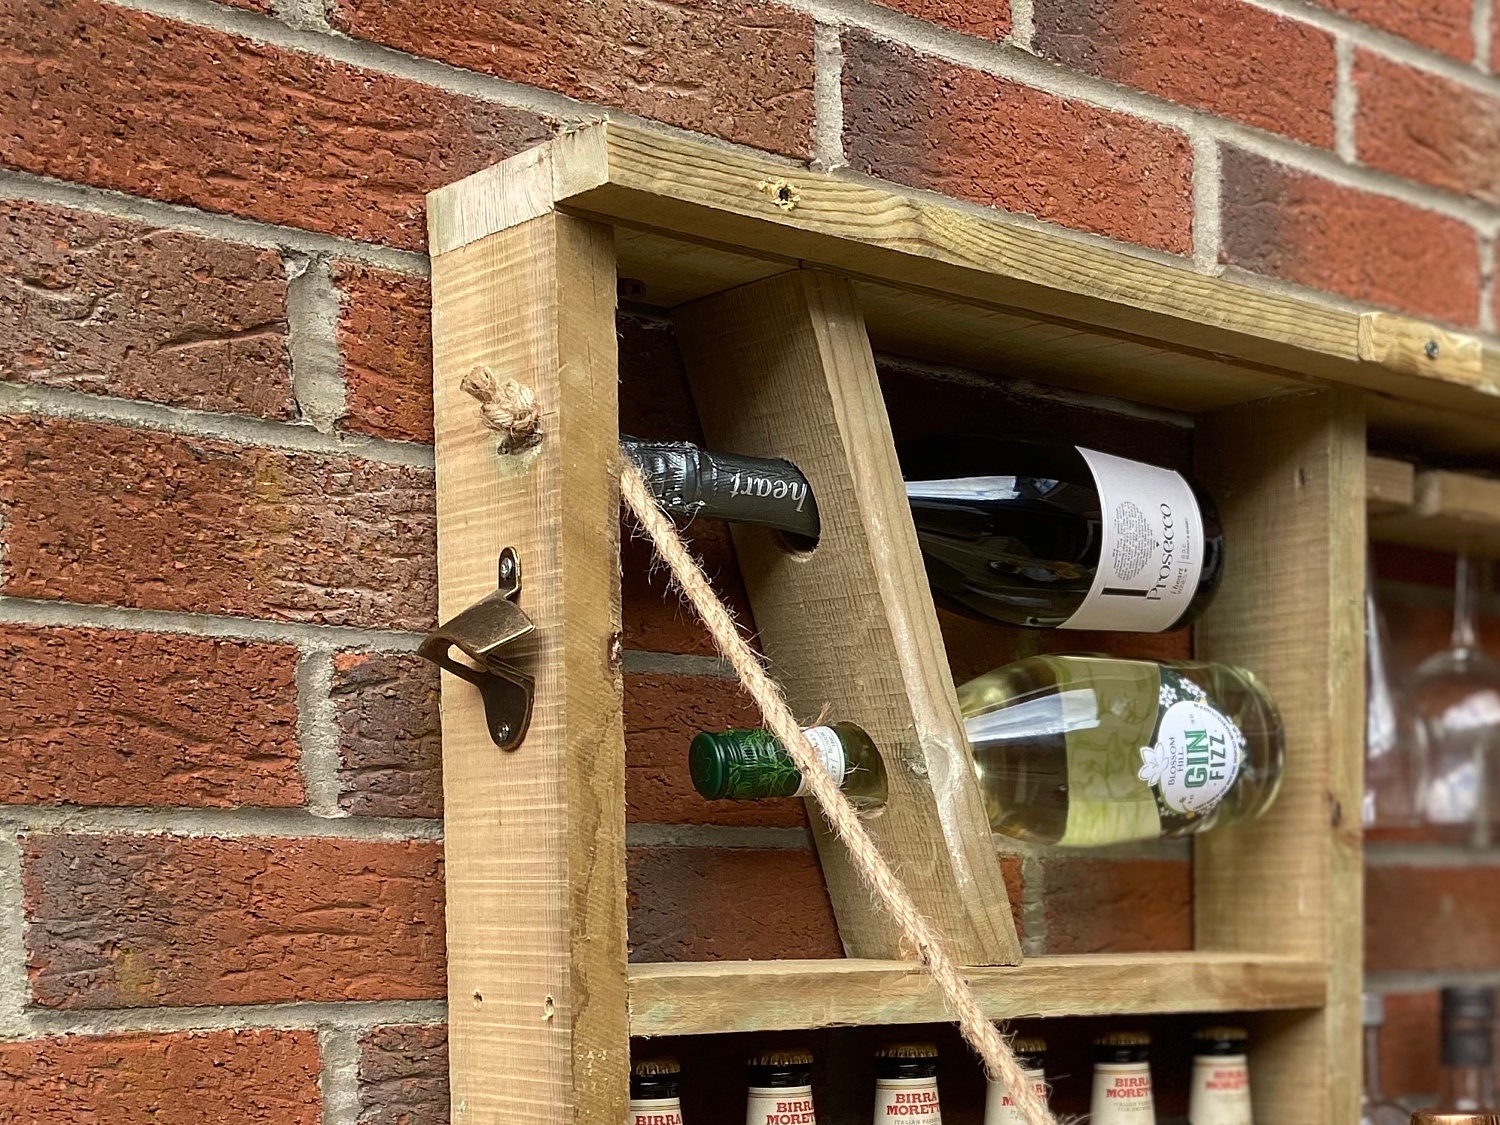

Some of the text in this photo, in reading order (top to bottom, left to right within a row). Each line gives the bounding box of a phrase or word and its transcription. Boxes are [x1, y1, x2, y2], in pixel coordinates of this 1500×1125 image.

[729, 471, 808, 513] heart
[1146, 502, 1176, 600] Prosecco
[1168, 737, 1177, 785] BLOSSOM
[1177, 746, 1185, 772] HILL
[1184, 728, 1209, 788] GIN
[1209, 734, 1226, 780] FIZZ
[896, 1091, 938, 1104] BIRRA
